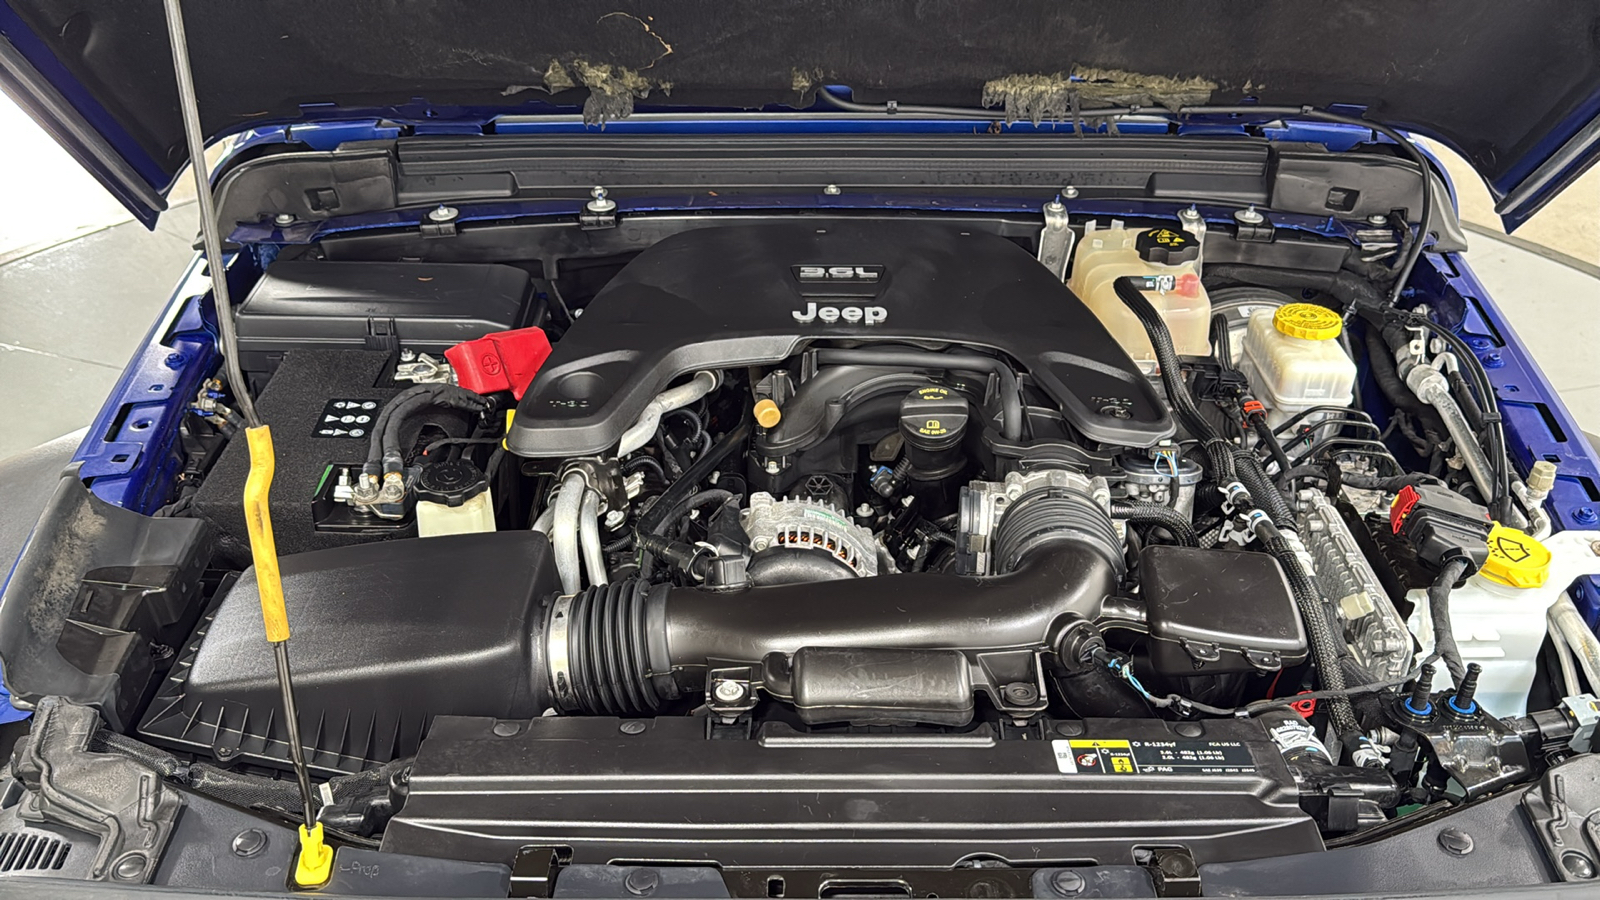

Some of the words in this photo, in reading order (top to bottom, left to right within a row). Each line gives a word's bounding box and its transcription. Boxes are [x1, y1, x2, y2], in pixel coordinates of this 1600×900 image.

[799, 266, 878, 278] 3.6L
[792, 302, 888, 325] Jeep
[919, 427, 931, 435] SAE
